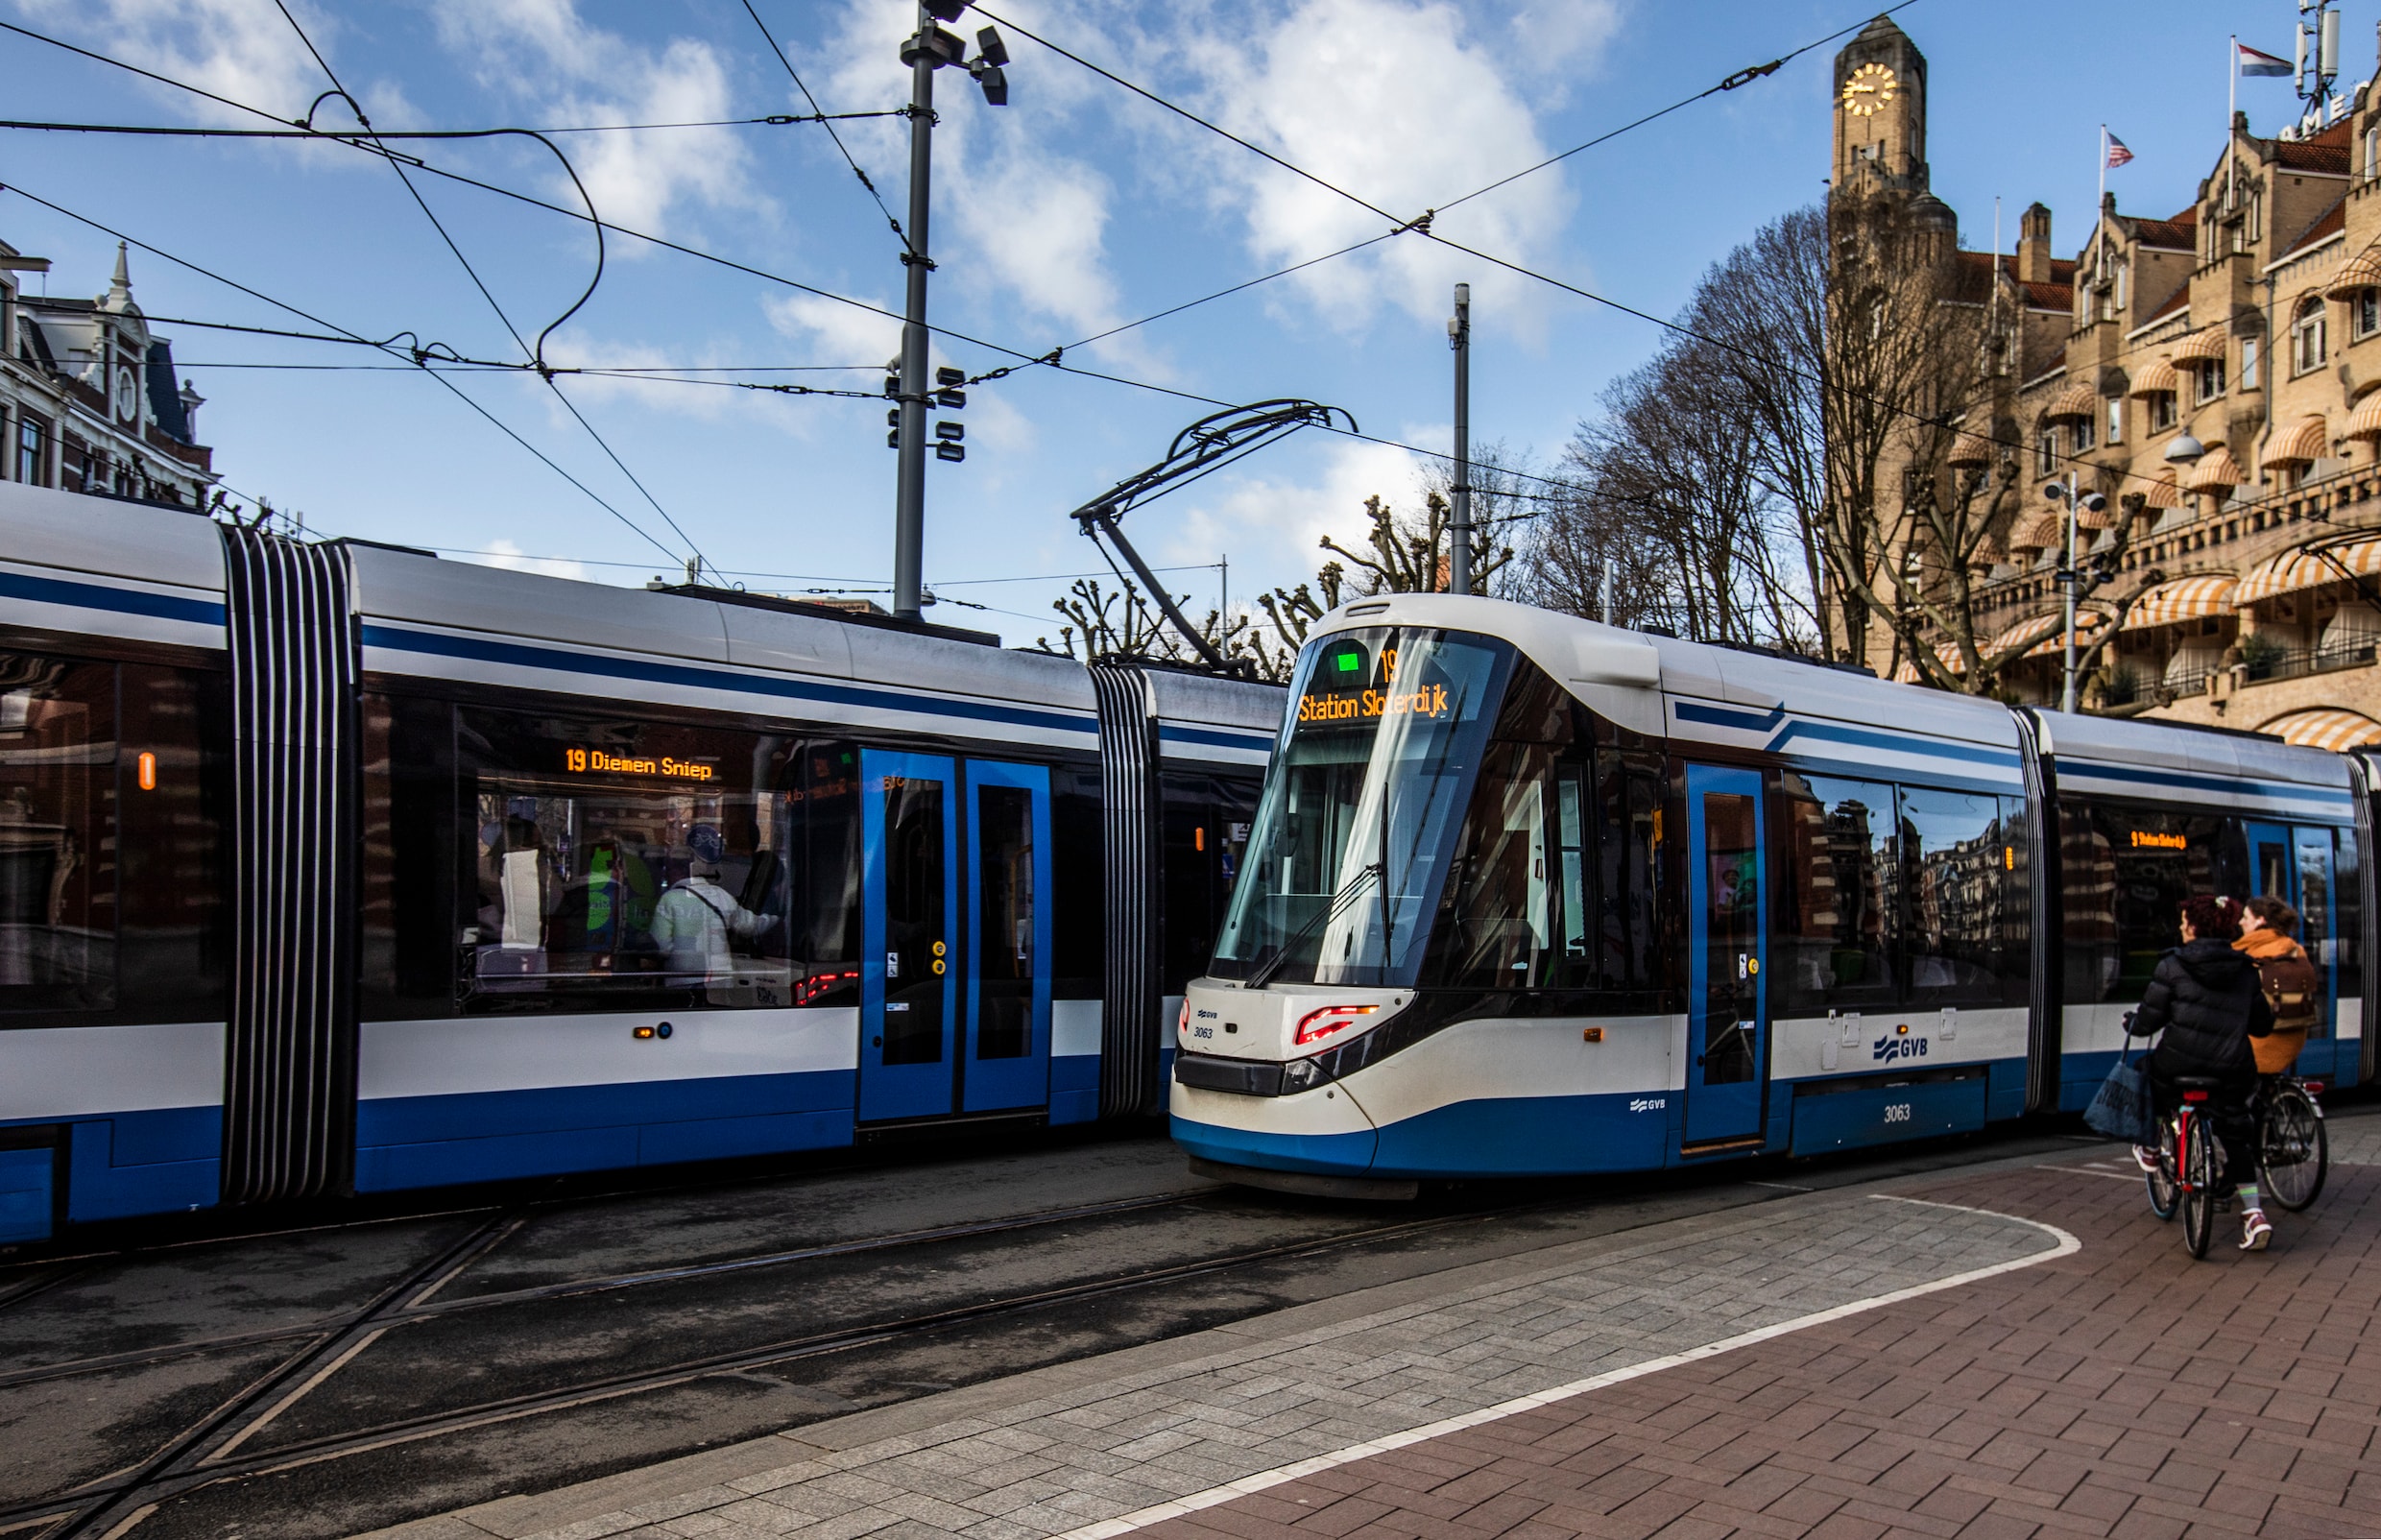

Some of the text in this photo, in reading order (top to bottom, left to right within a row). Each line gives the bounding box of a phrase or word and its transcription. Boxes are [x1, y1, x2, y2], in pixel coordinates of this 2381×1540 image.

[1381, 648, 1400, 684] 19
[1299, 684, 1449, 721] Station Sloterdijk
[566, 748, 712, 781] 19 Diemen Sniep
[1194, 1026, 1214, 1039] 3063
[1901, 1038, 1928, 1057] GVB
[1647, 1098, 1666, 1110] GVB
[1884, 1103, 1911, 1123] 3063
